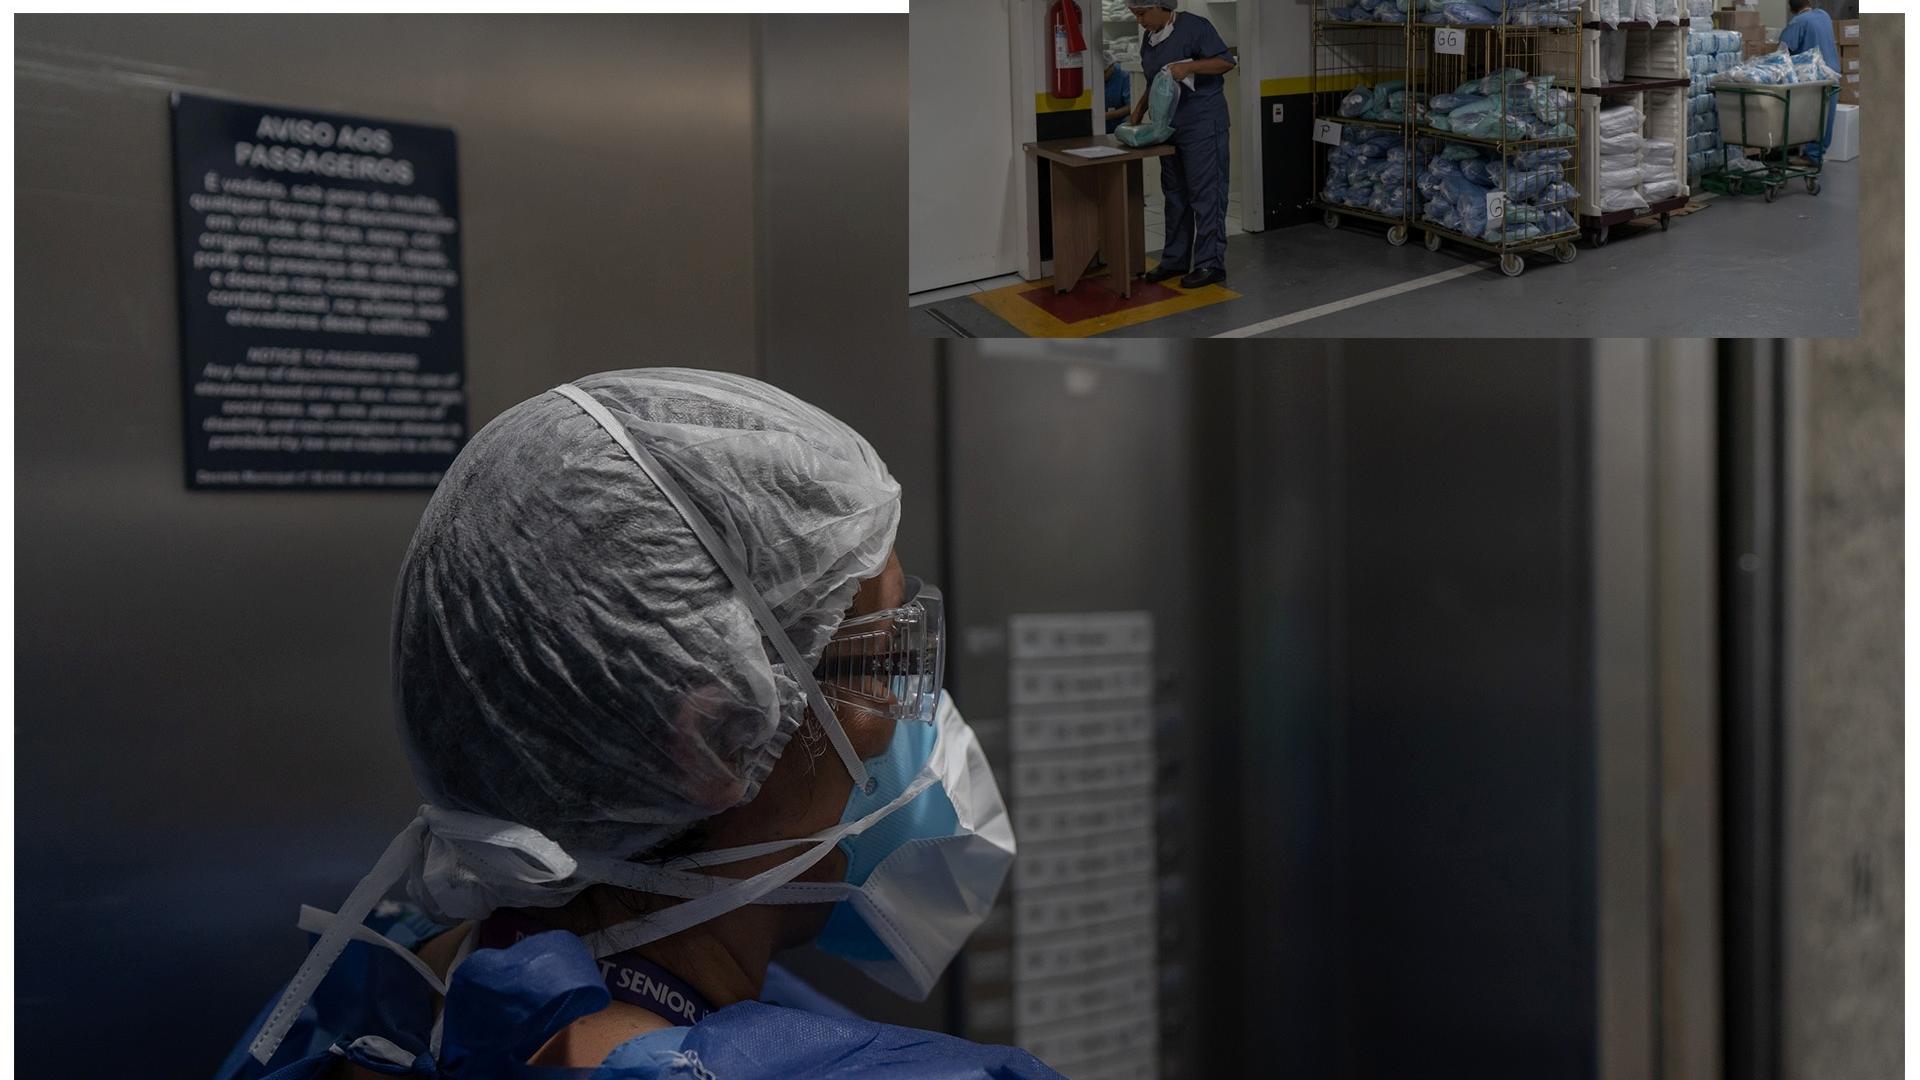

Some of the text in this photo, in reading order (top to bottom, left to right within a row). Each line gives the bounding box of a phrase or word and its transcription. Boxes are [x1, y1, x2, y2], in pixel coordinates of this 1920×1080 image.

[256, 115, 394, 154] AVISO AOS
[1319, 124, 1330, 139] P
[235, 142, 415, 186] PASSAGEIROS
[1489, 197, 1503, 218] G
[616, 967, 698, 1024] SENIOR
